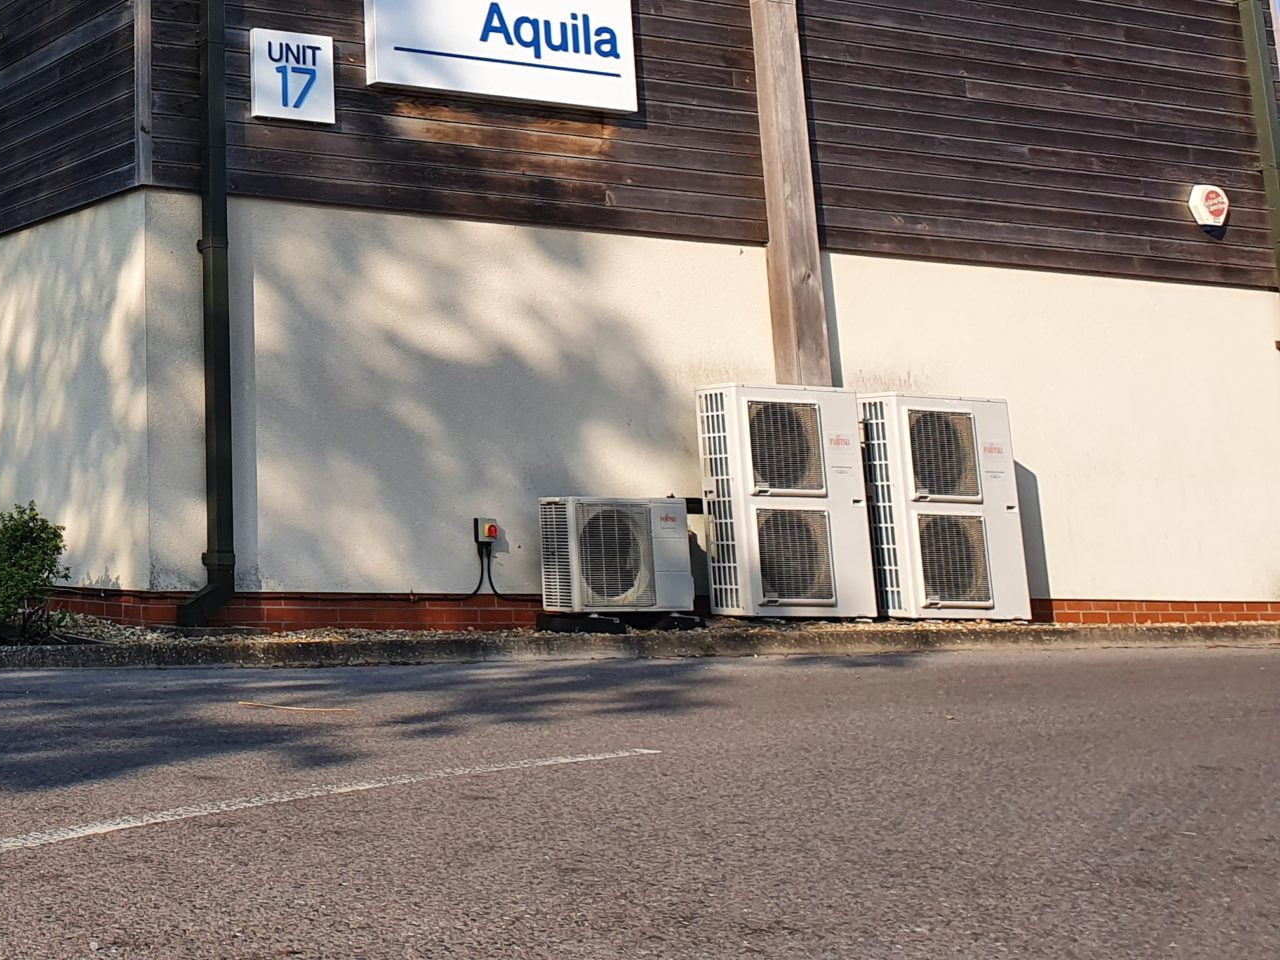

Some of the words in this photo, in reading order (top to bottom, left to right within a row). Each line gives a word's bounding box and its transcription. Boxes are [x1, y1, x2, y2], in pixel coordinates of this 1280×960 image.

[479, 2, 620, 59] Aquila
[267, 41, 322, 67] UNIT
[275, 65, 317, 109] 17
